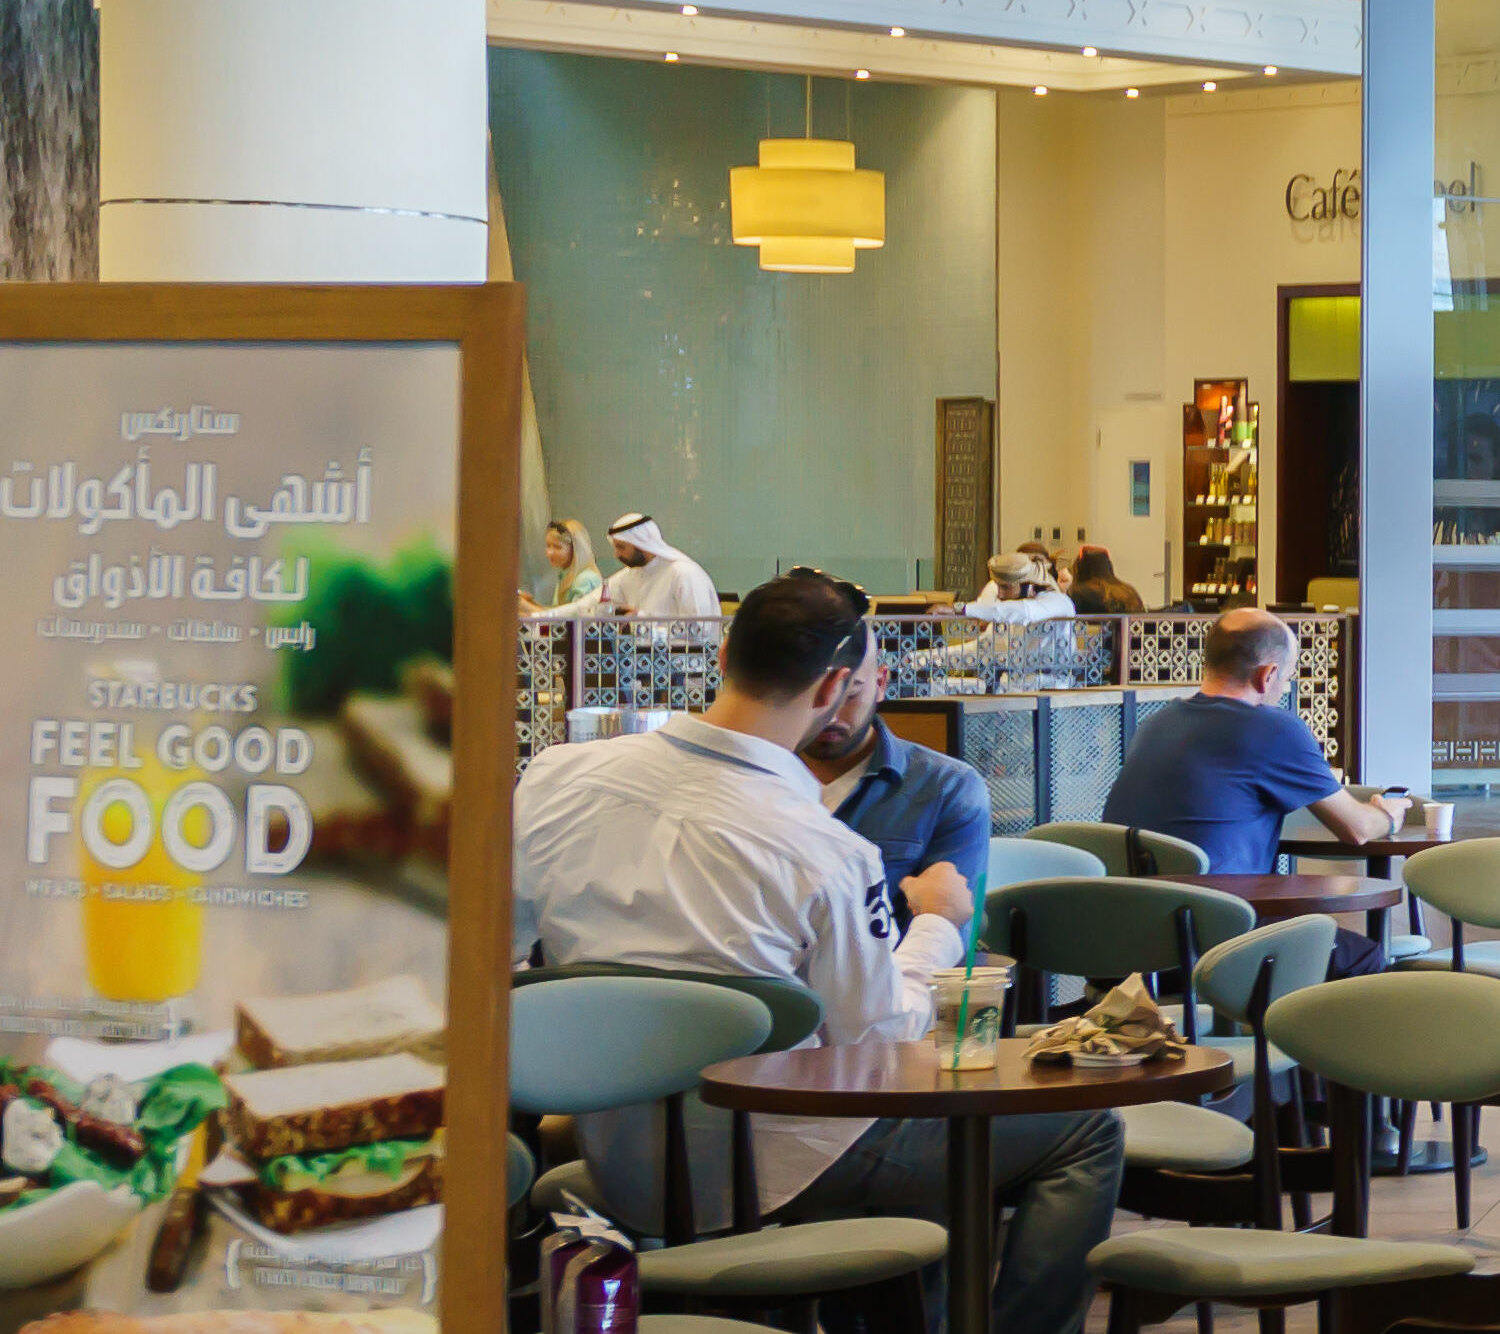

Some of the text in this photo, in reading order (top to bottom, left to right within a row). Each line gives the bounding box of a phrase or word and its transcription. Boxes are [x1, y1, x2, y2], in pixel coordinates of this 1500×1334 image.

[1285, 168, 1361, 221] Café
[0, 445, 373, 538] أشهى المأكولات
[54, 545, 310, 608] لكافة الأذواق
[87, 680, 260, 712] STARBUCKS
[31, 720, 314, 775] FEEL GOOD
[27, 775, 313, 875] FOOD
